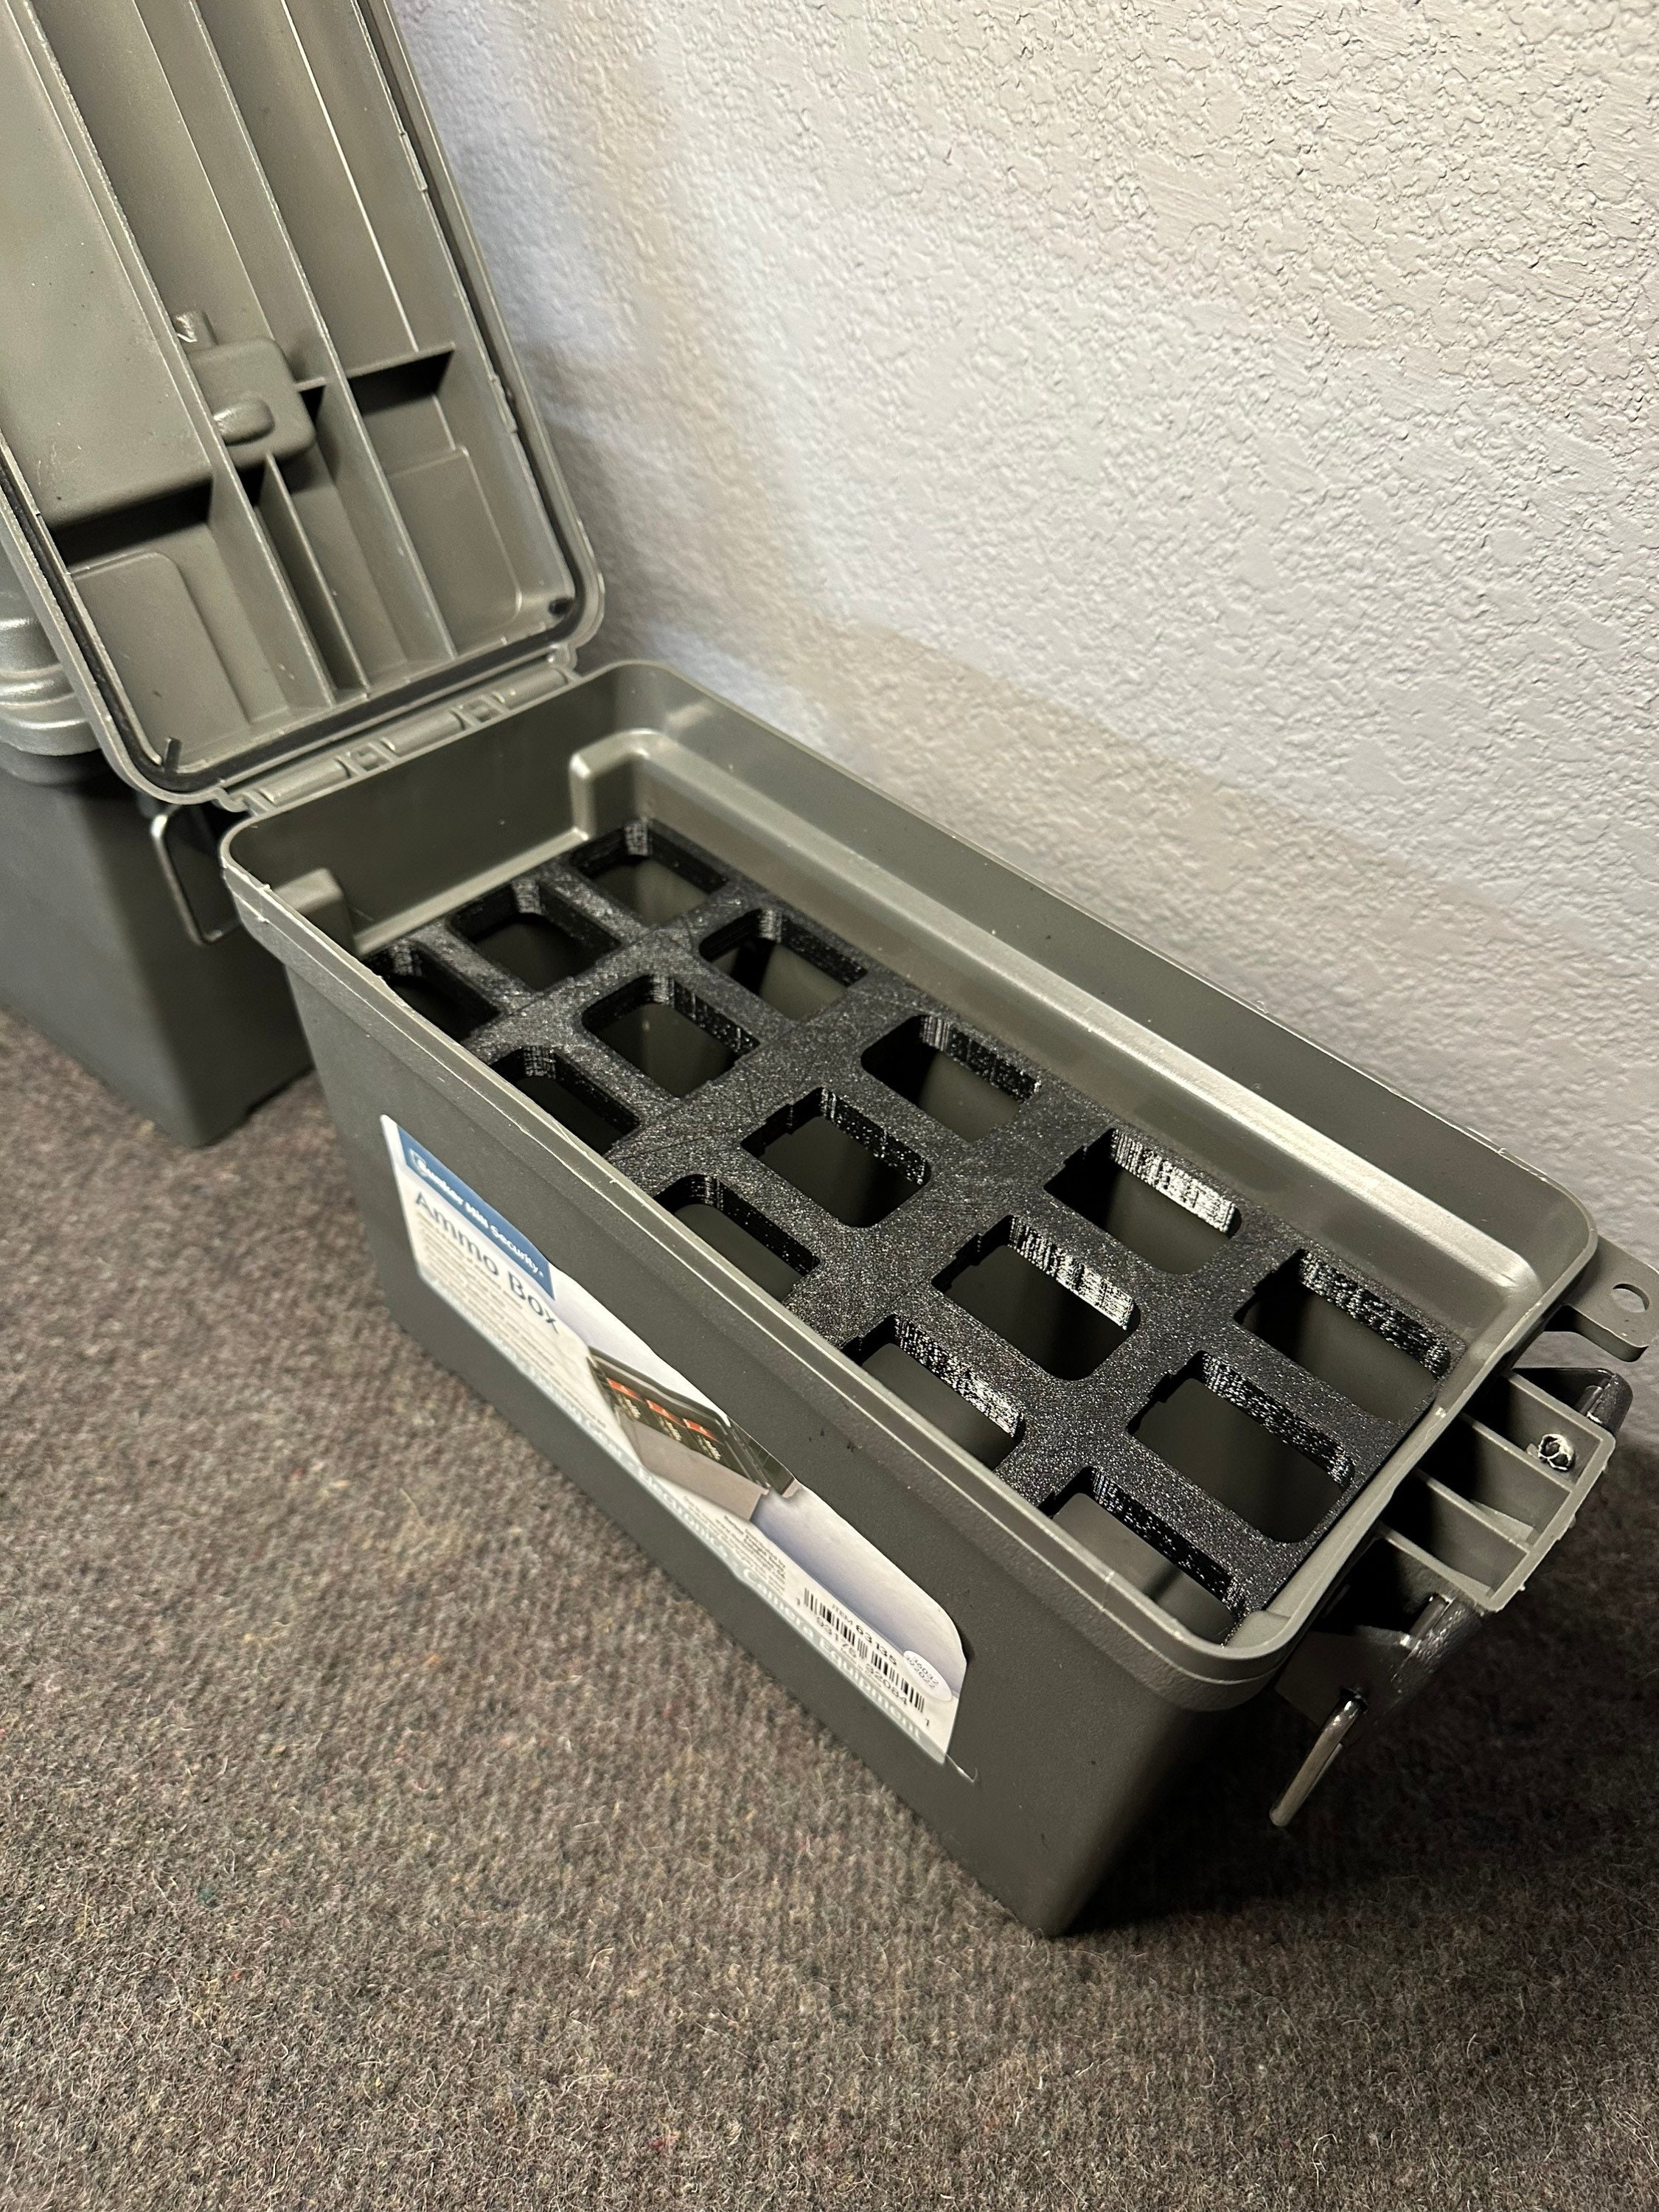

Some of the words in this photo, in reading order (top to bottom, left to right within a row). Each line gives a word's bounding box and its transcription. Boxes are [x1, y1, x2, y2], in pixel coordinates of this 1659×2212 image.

[415, 1192, 499, 1276] Ammo
[507, 1270, 559, 1335] Box
[490, 1225, 540, 1273] Security
[743, 1568, 814, 1639] Camera
[820, 1637, 922, 1741] Equipment
[816, 1616, 857, 1658] 93175
[866, 1663, 907, 1705] 32084
[832, 1604, 853, 1625] ITEM
[856, 1624, 897, 1666] 63135
